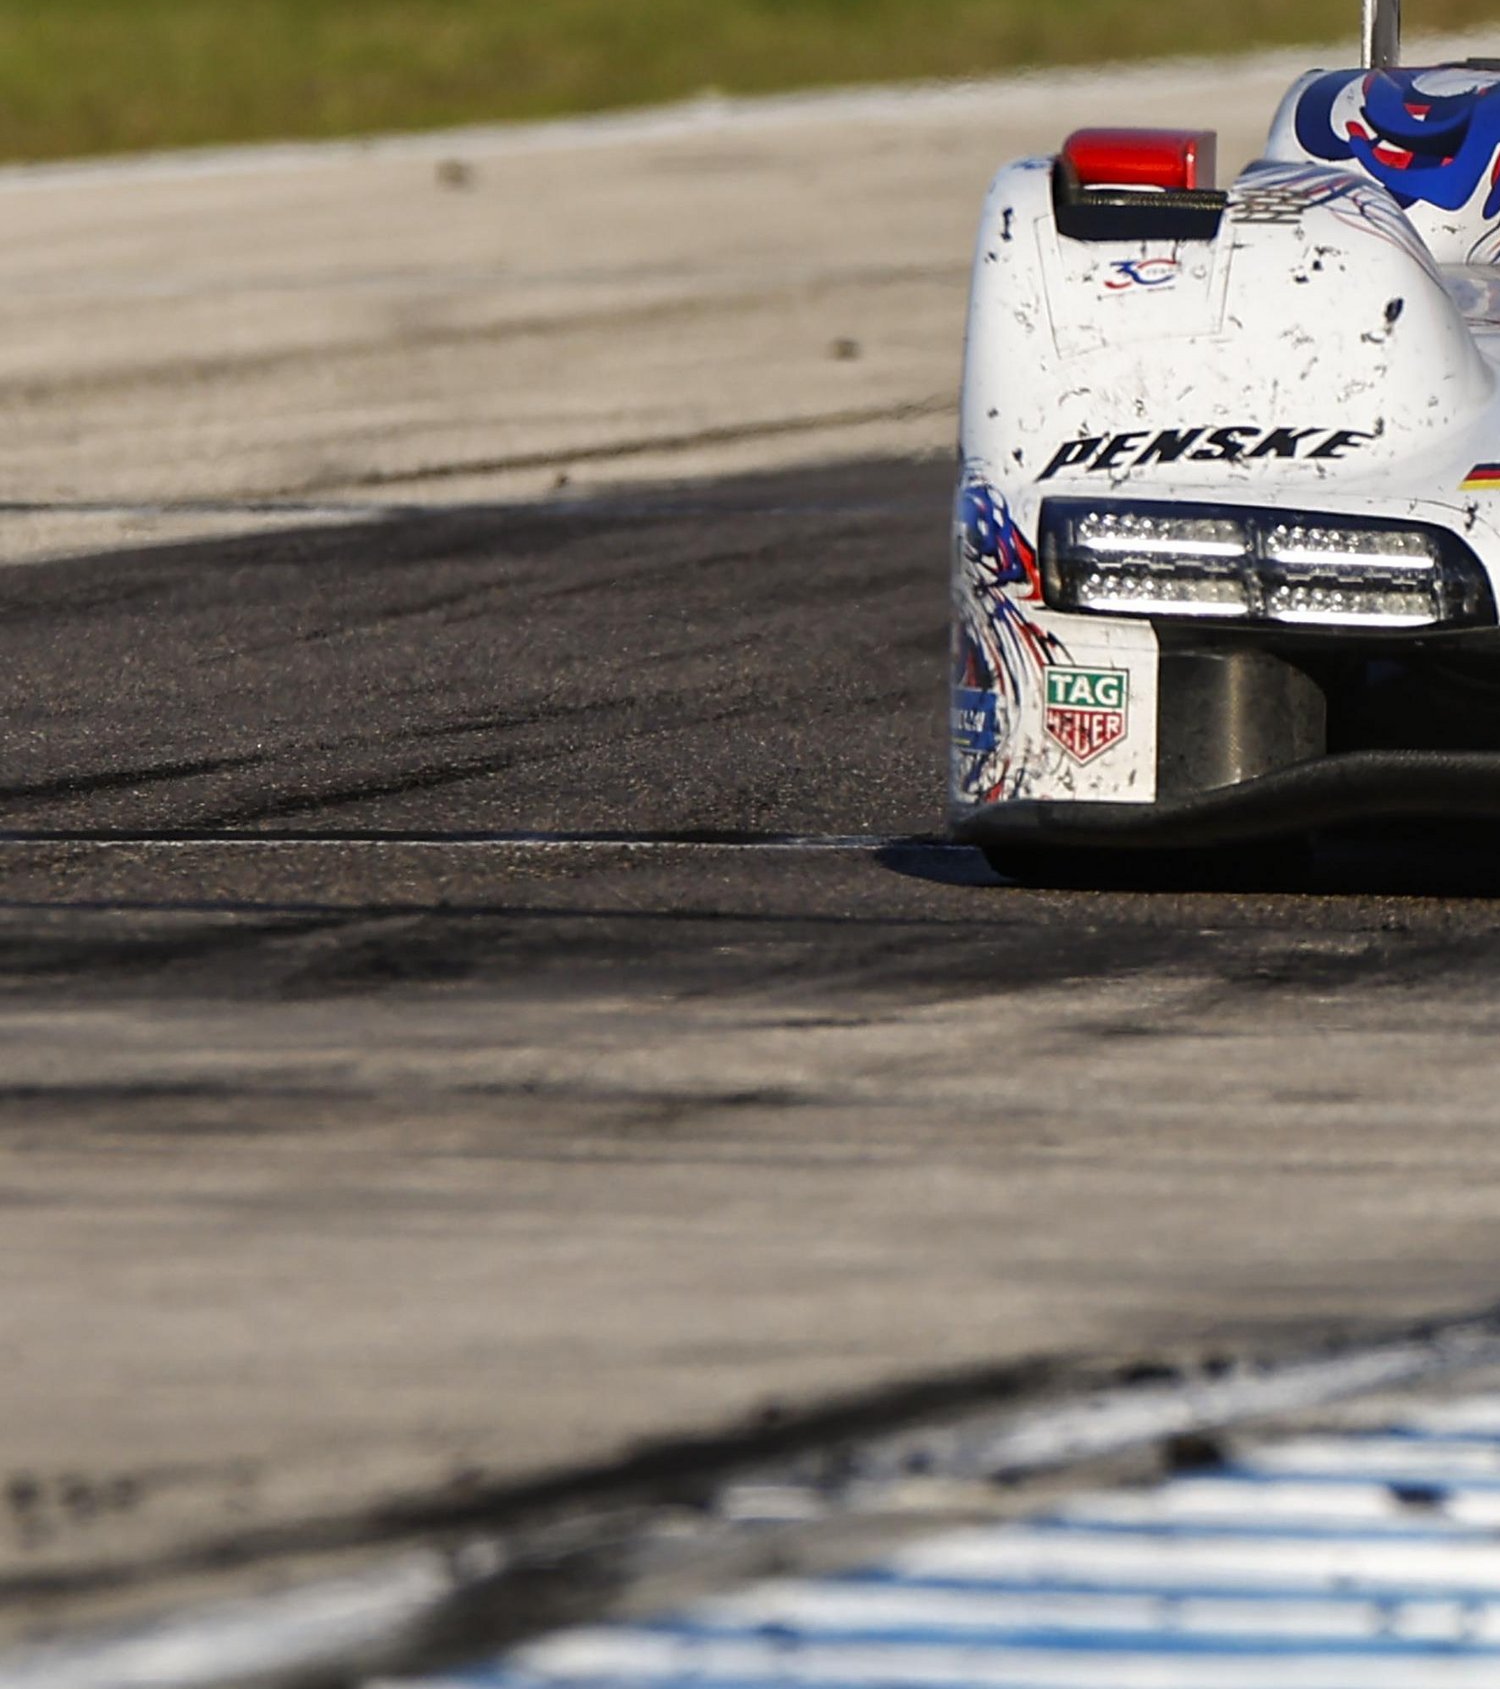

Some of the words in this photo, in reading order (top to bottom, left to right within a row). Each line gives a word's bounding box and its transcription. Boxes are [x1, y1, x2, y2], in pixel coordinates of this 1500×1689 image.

[1033, 426, 1377, 483] PENSKE
[1049, 674, 1120, 706] TAG
[1048, 711, 1122, 756] HEUER
